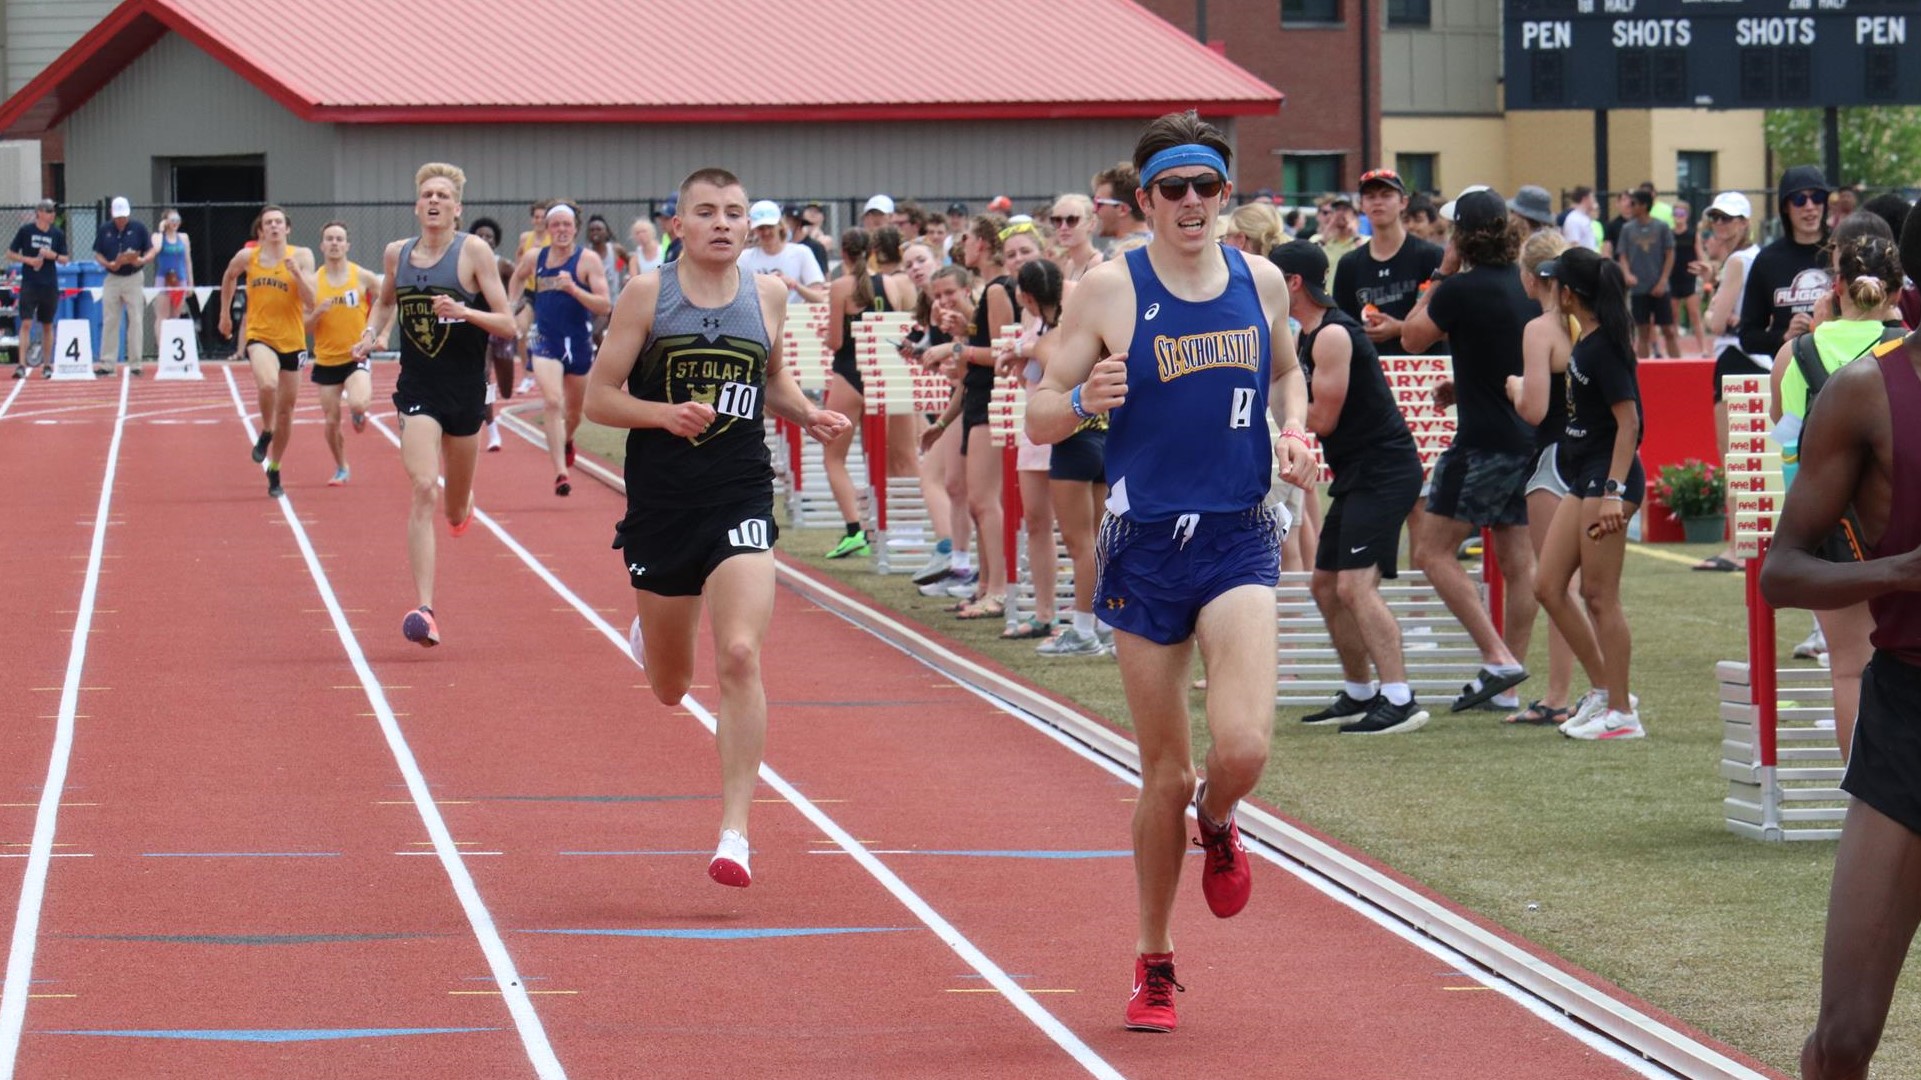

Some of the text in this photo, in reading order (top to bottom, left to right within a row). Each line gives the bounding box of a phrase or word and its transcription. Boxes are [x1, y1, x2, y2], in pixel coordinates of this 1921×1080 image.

[1523, 21, 1571, 49] PEN
[1612, 19, 1691, 47] SHOTS
[1736, 17, 1815, 45] SHOTS
[1856, 16, 1905, 44] PEN
[417, 303, 434, 315] OL
[65, 338, 80, 361] 4
[172, 338, 186, 361] 3
[1156, 328, 1259, 380] ST. SCHOLASTICA
[675, 361, 743, 382] ST. OLAF
[726, 384, 752, 416] 10
[737, 520, 762, 547] 10
